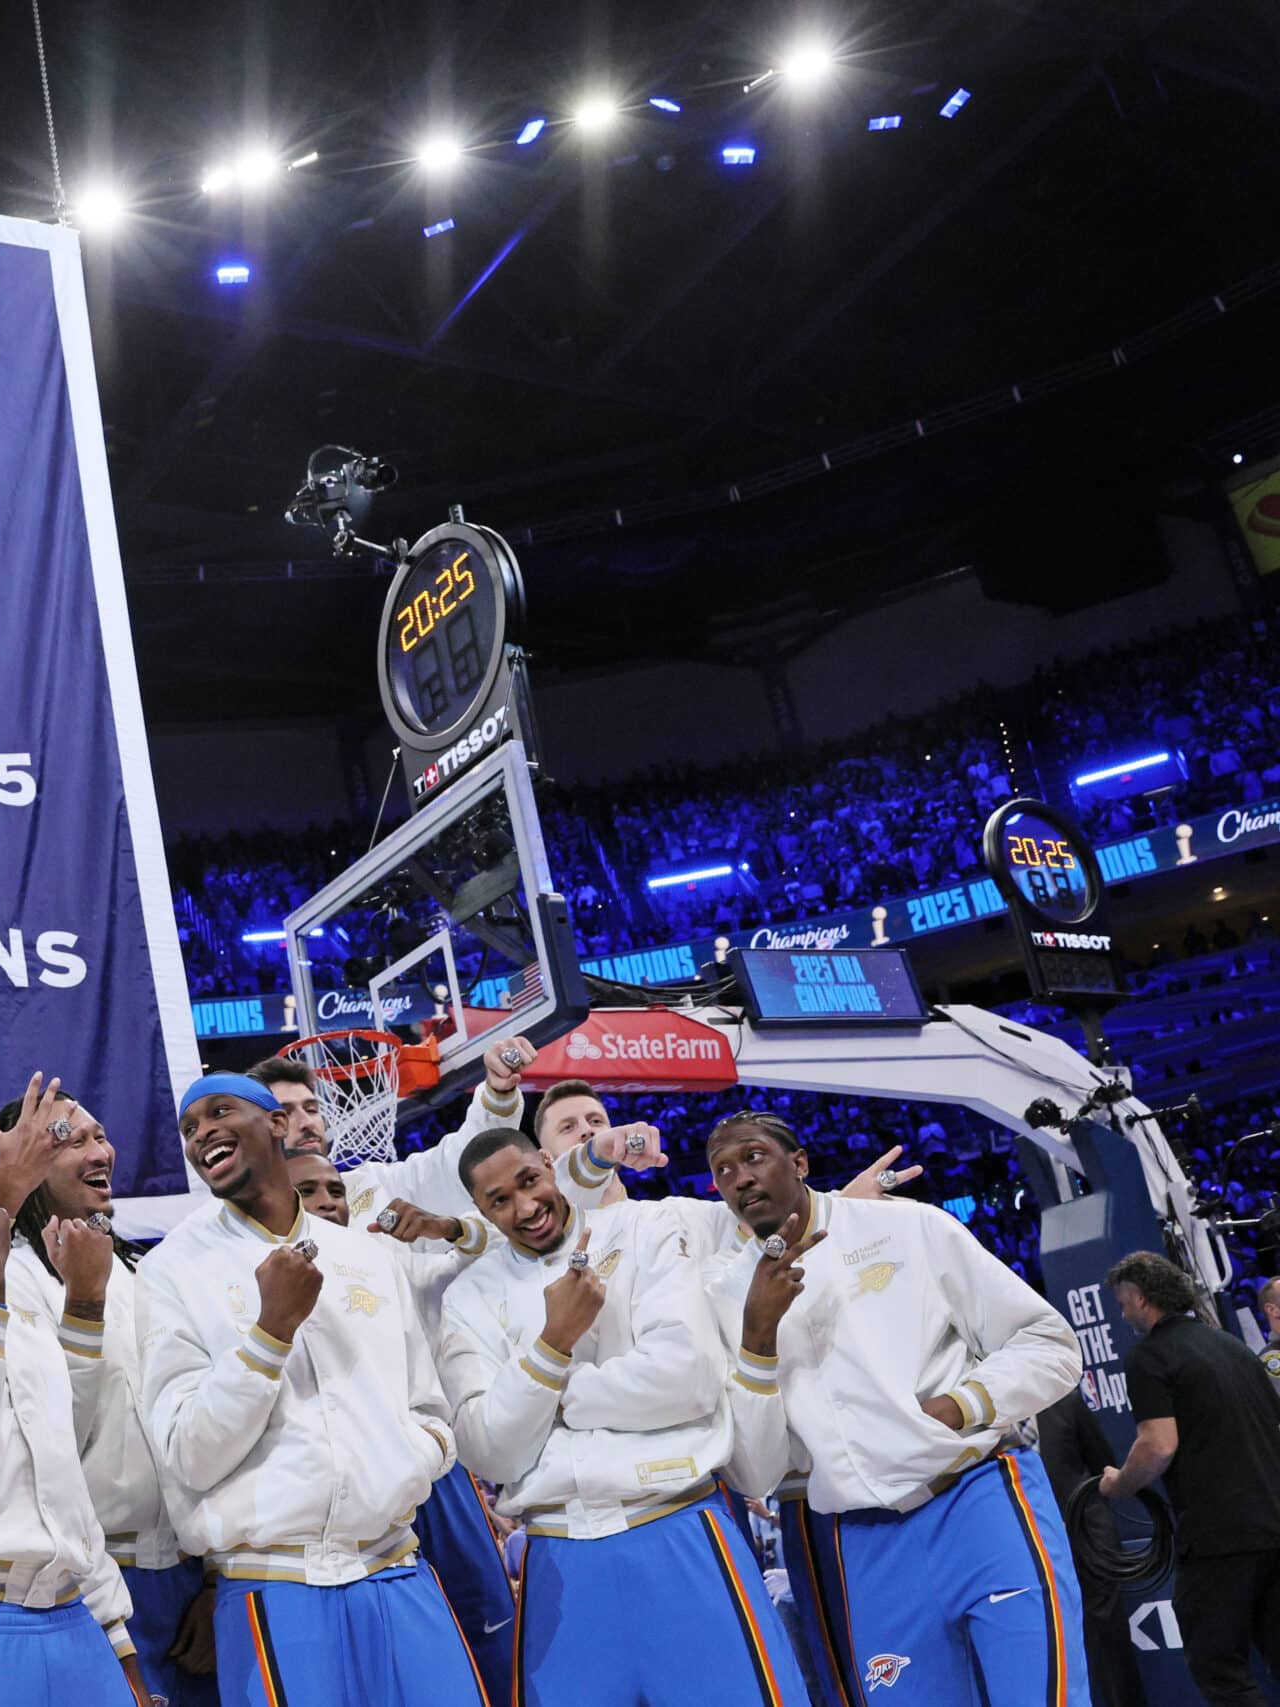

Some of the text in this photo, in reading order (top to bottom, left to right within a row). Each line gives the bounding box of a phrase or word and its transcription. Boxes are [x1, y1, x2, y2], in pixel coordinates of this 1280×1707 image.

[396, 552, 475, 653] 20:25
[1217, 810, 1280, 843] Cham
[1008, 836, 1076, 869] 20:25
[906, 887, 971, 933] 2025
[969, 878, 1008, 917] NB
[750, 924, 850, 950] Champions
[1054, 933, 1112, 951] TISSOT
[790, 955, 835, 984] 2025
[793, 983, 883, 1012] CHAMPIONS
[1067, 1283, 1105, 1326] GET
[1076, 1323, 1119, 1366] THE
